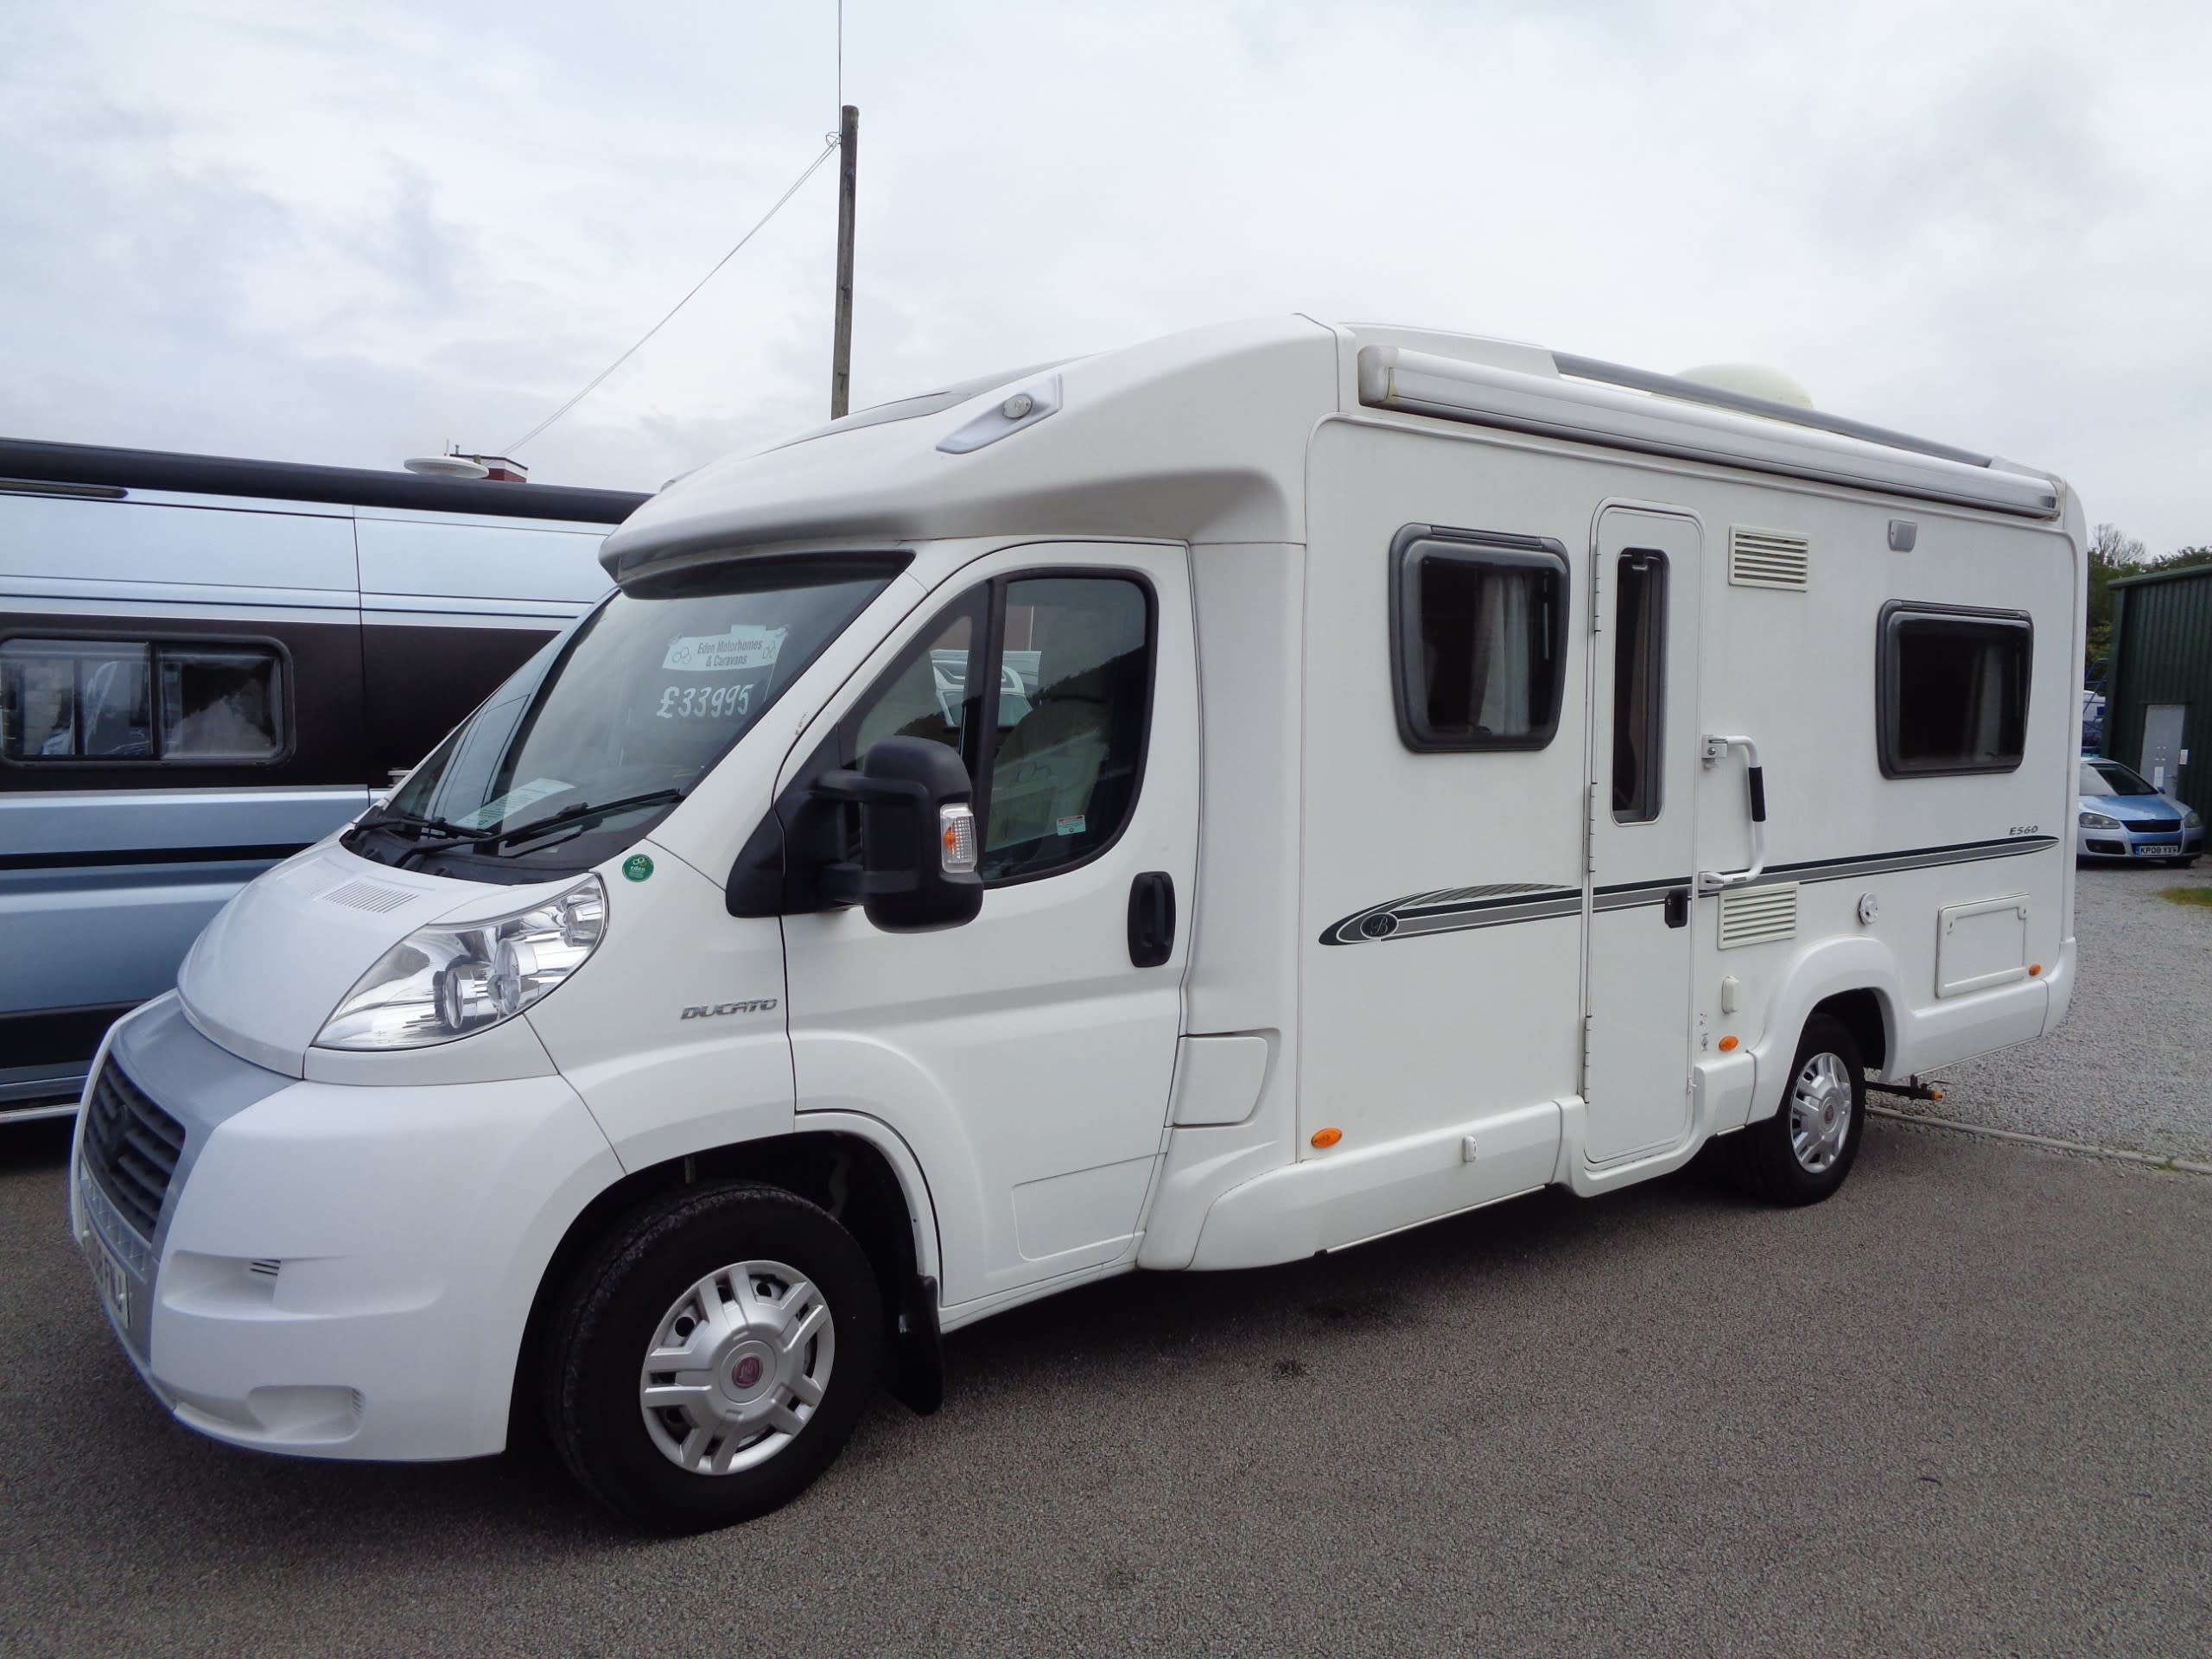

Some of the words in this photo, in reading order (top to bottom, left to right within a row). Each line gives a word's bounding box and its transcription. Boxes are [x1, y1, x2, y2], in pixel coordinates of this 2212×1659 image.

[697, 642, 715, 655] Eden
[717, 639, 763, 654] Motorhomes
[705, 657, 712, 667] &
[714, 654, 748, 666] Caravans
[657, 683, 754, 719] £33995
[2009, 825, 2039, 836] E560
[680, 998, 778, 1020] DUCATO
